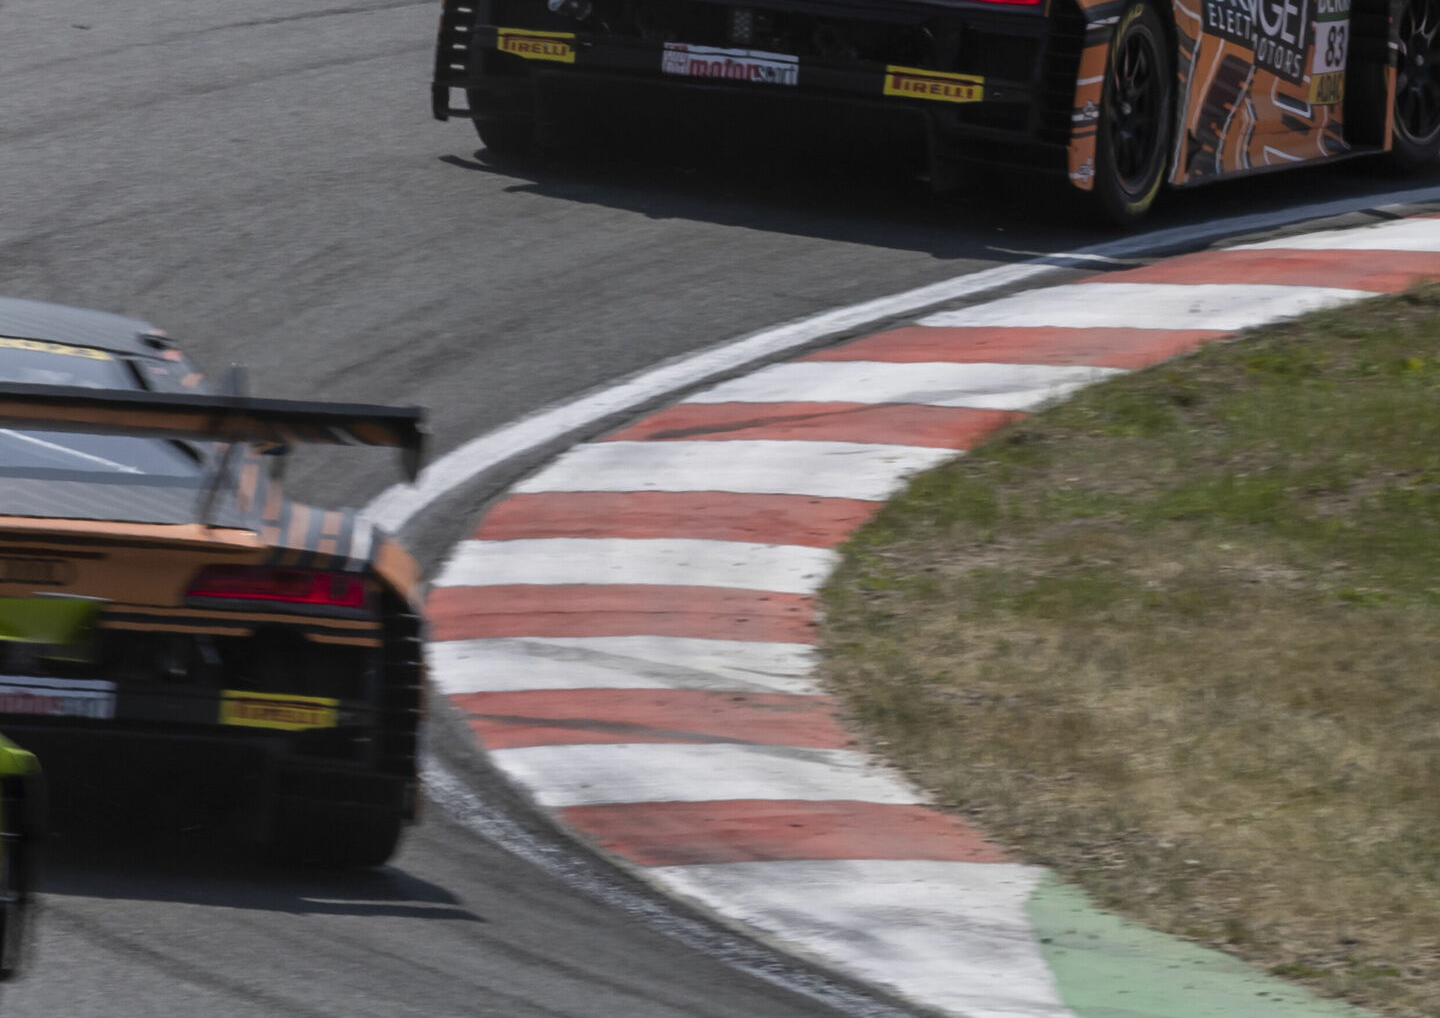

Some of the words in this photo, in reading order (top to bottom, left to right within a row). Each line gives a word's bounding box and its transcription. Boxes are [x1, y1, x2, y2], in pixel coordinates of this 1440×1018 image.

[503, 32, 567, 57] PIRELLI
[1325, 24, 1345, 68] 83
[891, 71, 975, 100] PIRELLI
